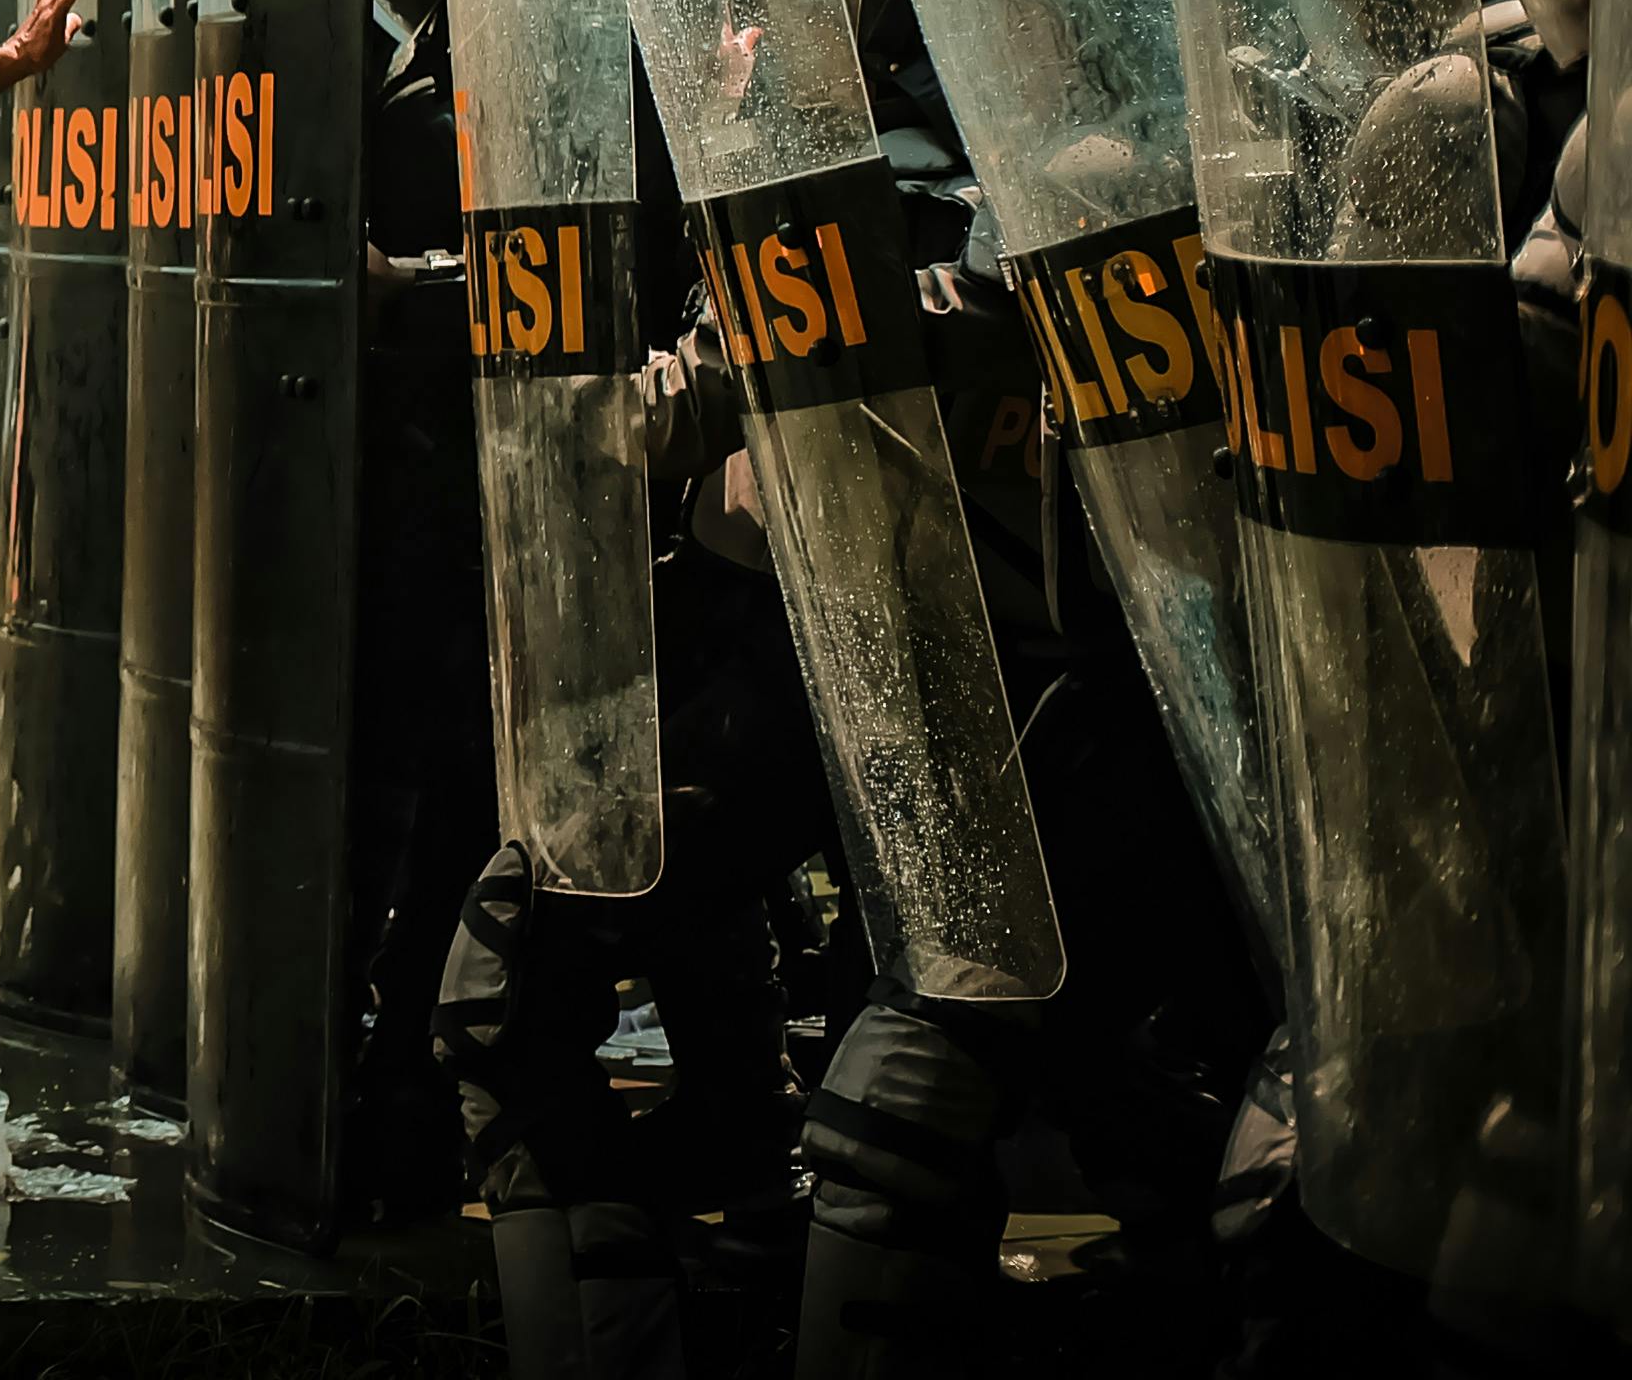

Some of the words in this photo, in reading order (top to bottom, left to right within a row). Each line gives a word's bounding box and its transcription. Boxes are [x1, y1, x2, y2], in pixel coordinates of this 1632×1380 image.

[14, 107, 118, 231] OLISI
[131, 95, 192, 229] LISI
[197, 71, 275, 218] LISI
[464, 225, 585, 356] LISI
[700, 222, 868, 365] LISI
